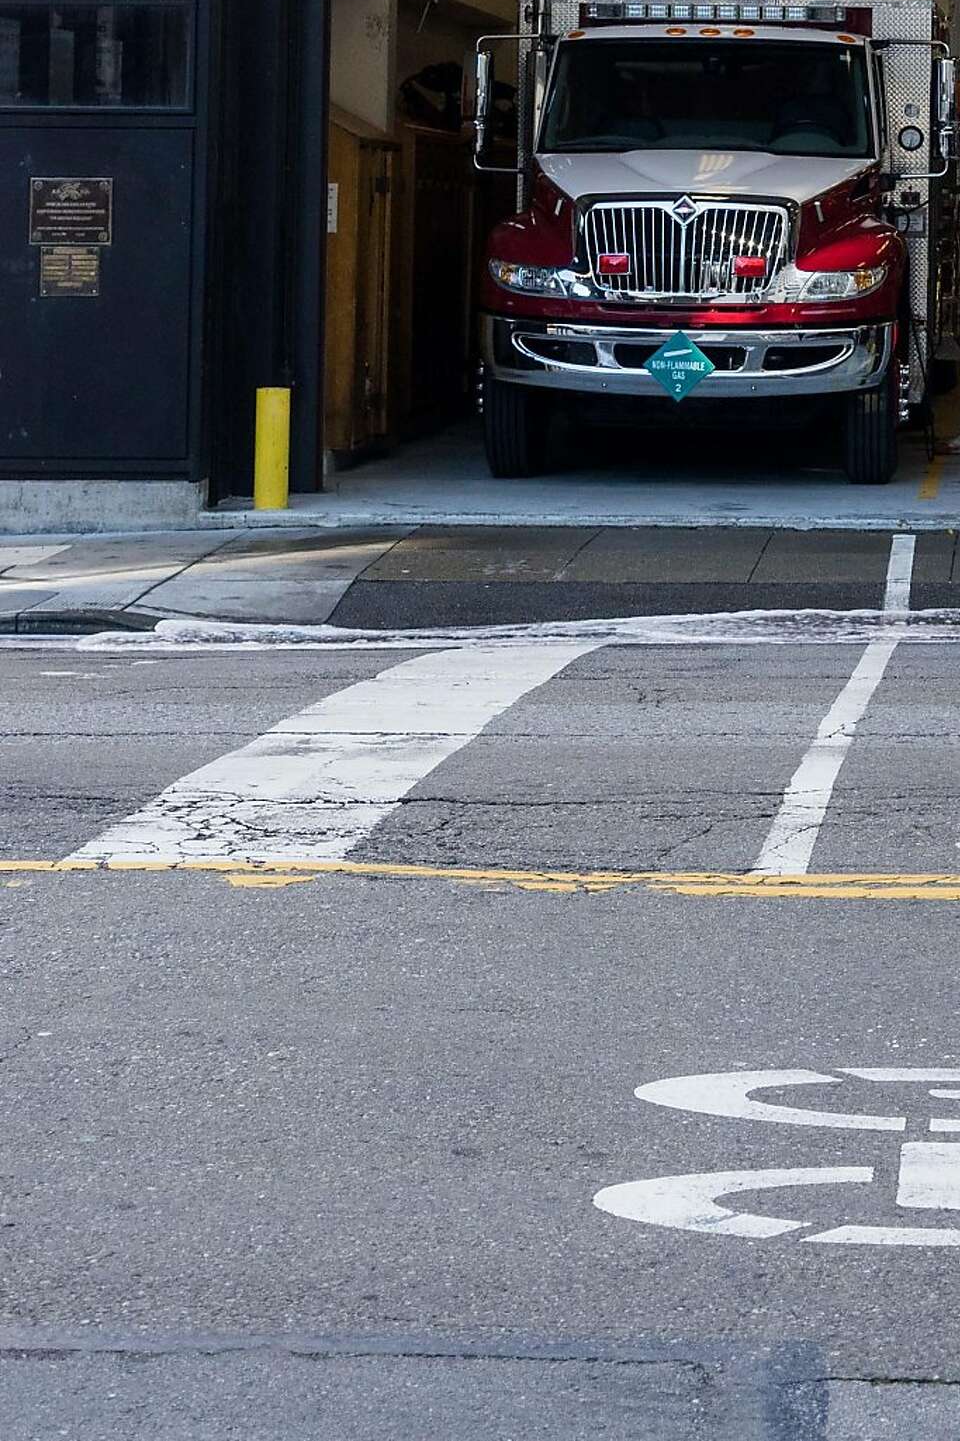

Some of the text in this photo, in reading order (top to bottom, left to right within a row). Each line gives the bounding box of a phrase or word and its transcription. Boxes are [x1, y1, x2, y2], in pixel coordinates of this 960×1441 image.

[651, 359, 706, 371] NON-FLAMMABLE
[671, 370, 686, 380] GAS
[674, 383, 682, 393] 2
